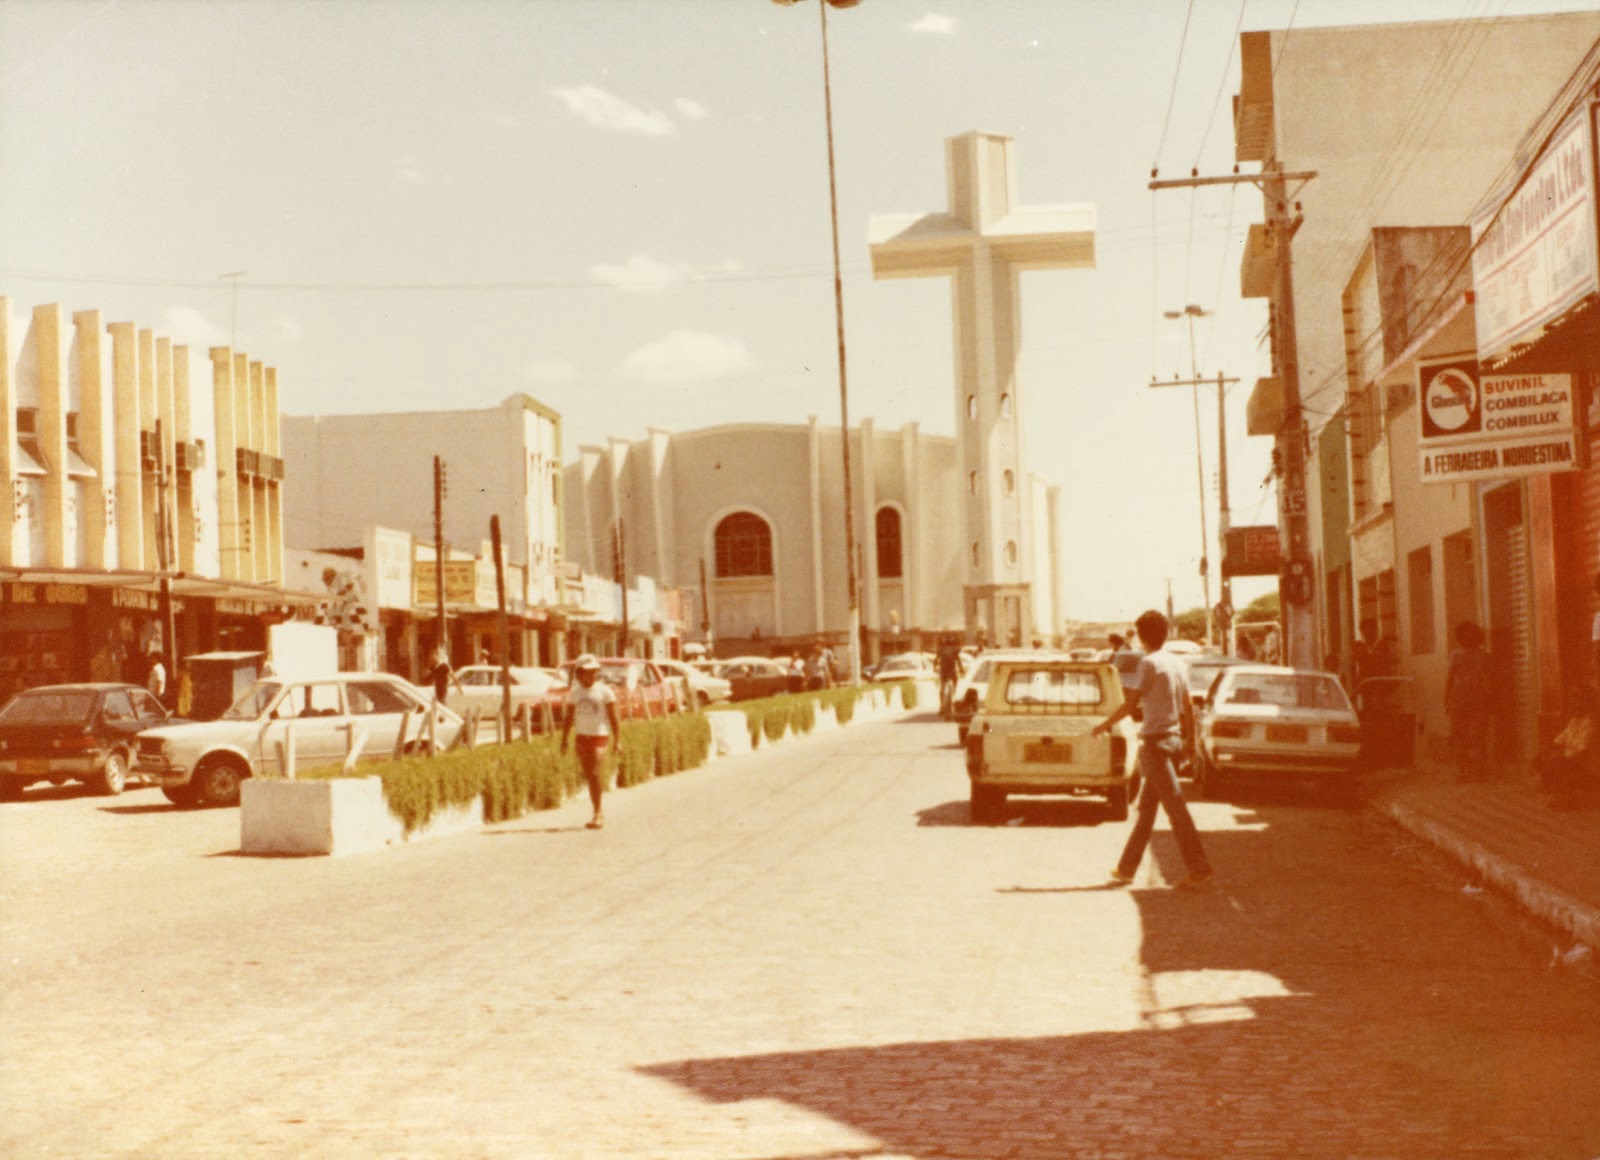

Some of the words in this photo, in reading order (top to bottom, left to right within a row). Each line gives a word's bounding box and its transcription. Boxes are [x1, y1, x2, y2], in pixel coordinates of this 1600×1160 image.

[1485, 376, 1547, 394] SUVINIL
[1485, 391, 1568, 411] COMBILACA
[1485, 411, 1560, 431] COMBILUX
[1424, 455, 1432, 475] A
[1435, 450, 1499, 474] FERRAGEIRA
[1502, 441, 1572, 468] NORDESTINA
[1283, 495, 1305, 514] 15
